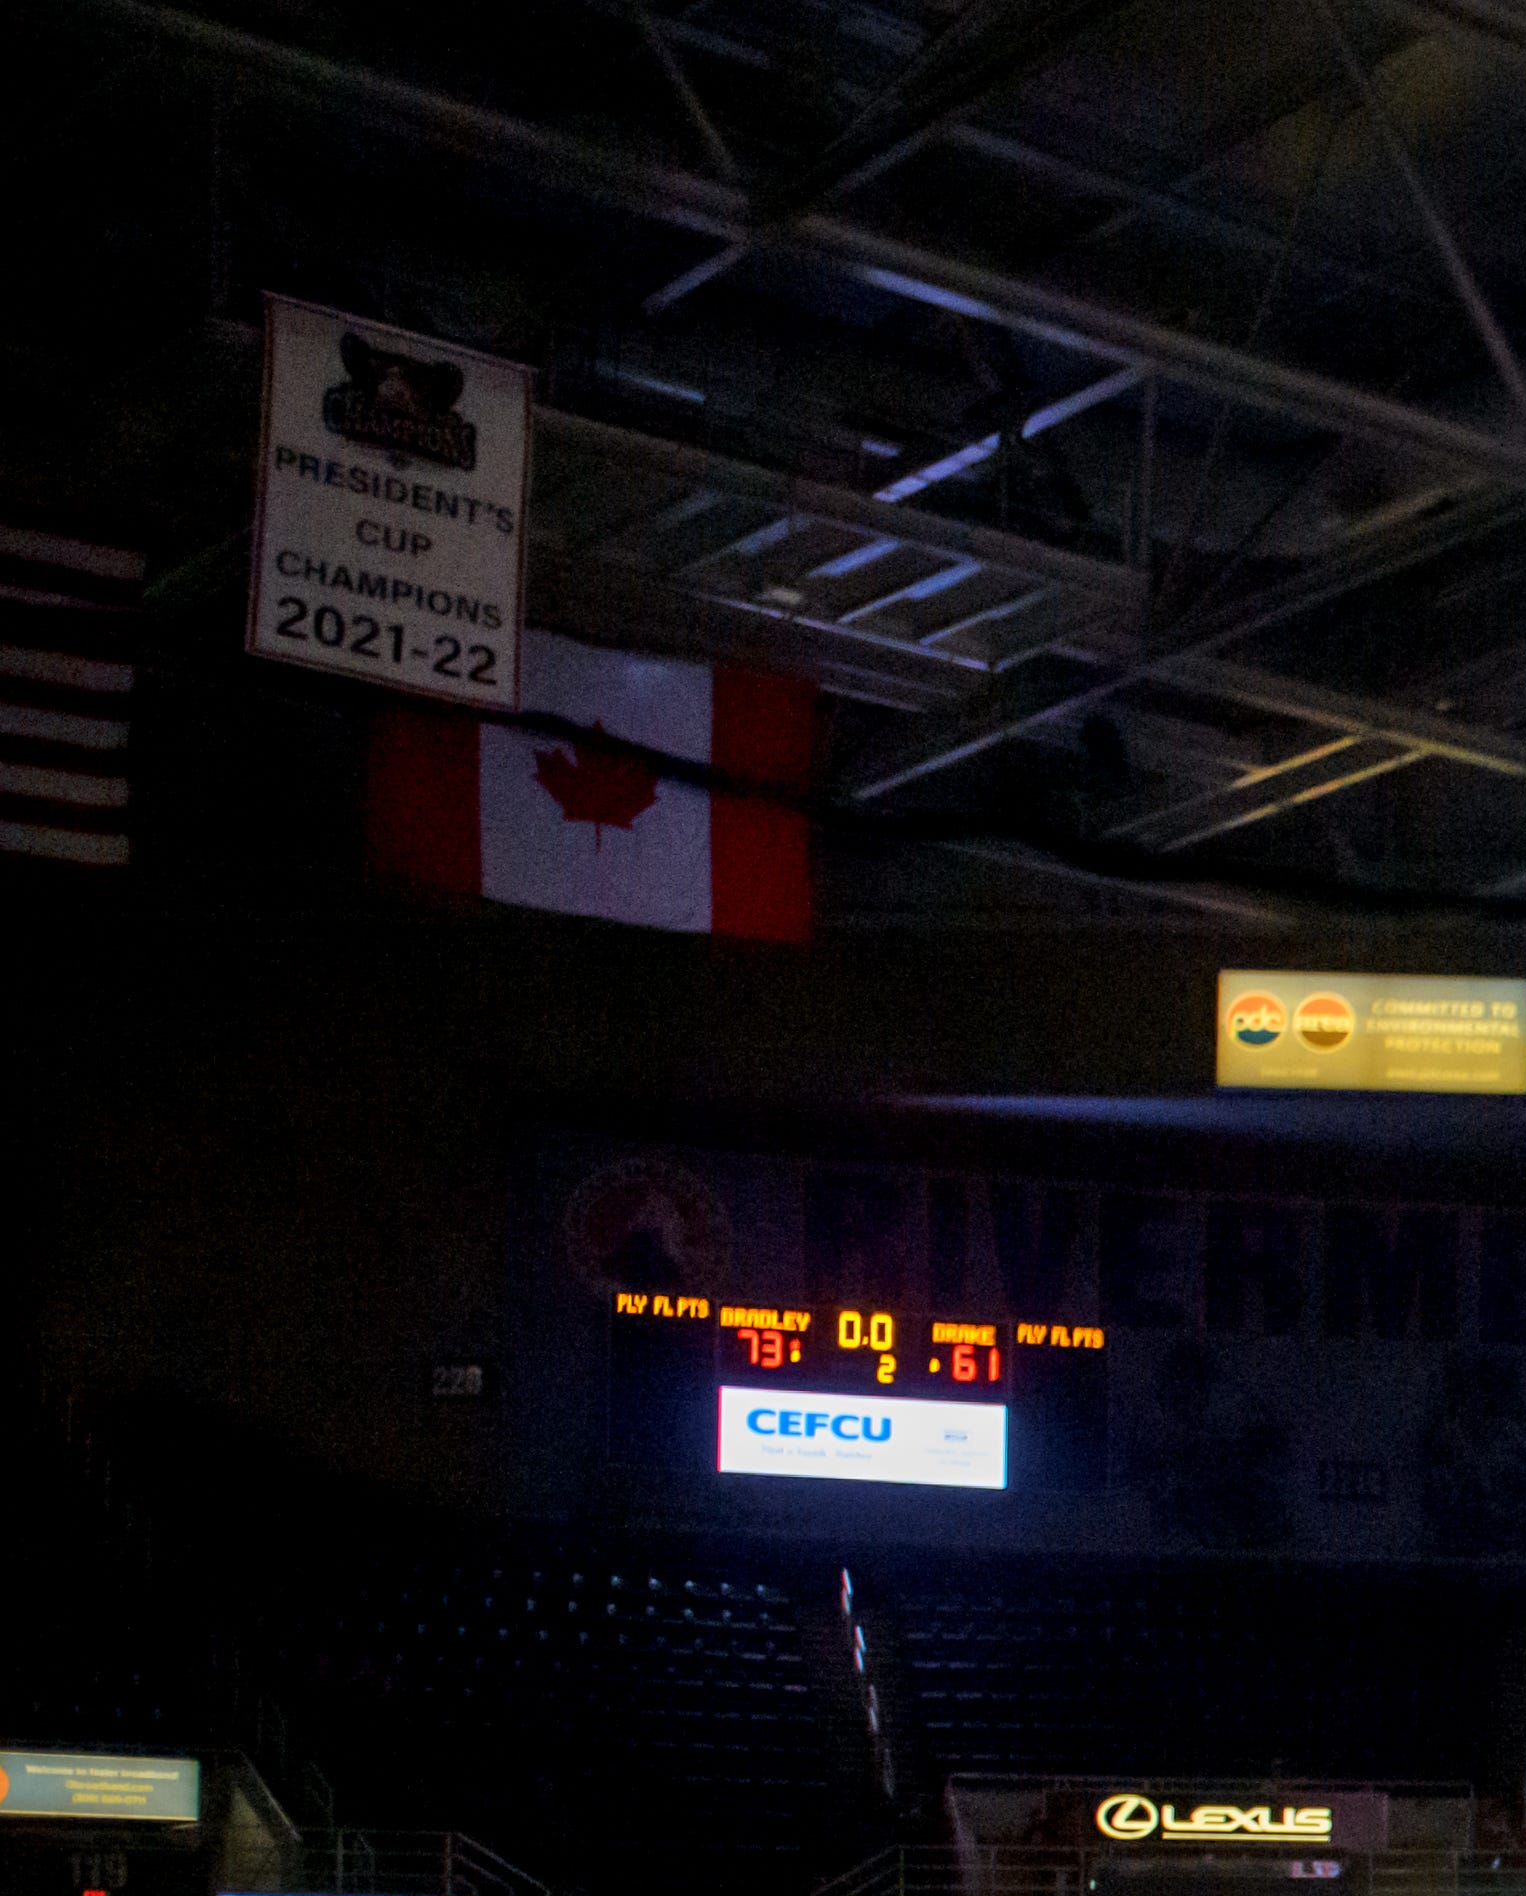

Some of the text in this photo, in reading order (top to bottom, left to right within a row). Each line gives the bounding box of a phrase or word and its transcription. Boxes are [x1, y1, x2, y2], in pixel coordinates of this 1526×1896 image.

[274, 445, 514, 535] PRESIDENT'S
[355, 518, 432, 556] CUP
[276, 549, 504, 631] CHAMPIONS
[276, 596, 497, 686] 2021-22
[1231, 1003, 1288, 1040] pdc
[1371, 997, 1518, 1020] COMMITTED TO
[1366, 1019, 1521, 1039] ENVIRONMENTAL
[1384, 1036, 1503, 1056] PROTECTION
[616, 1292, 710, 1319] PLY FL PTS
[720, 1306, 811, 1332] BRADLEY
[838, 1310, 893, 1351] 0.0
[932, 1321, 996, 1346] DRAKE
[1016, 1322, 1106, 1349] PLY FL PTS
[736, 1328, 784, 1369] 73
[951, 1343, 1001, 1383] 61
[876, 1353, 898, 1385] 2
[746, 1408, 893, 1443] CEFCU
[1161, 1807, 1333, 1834] LEXUS
